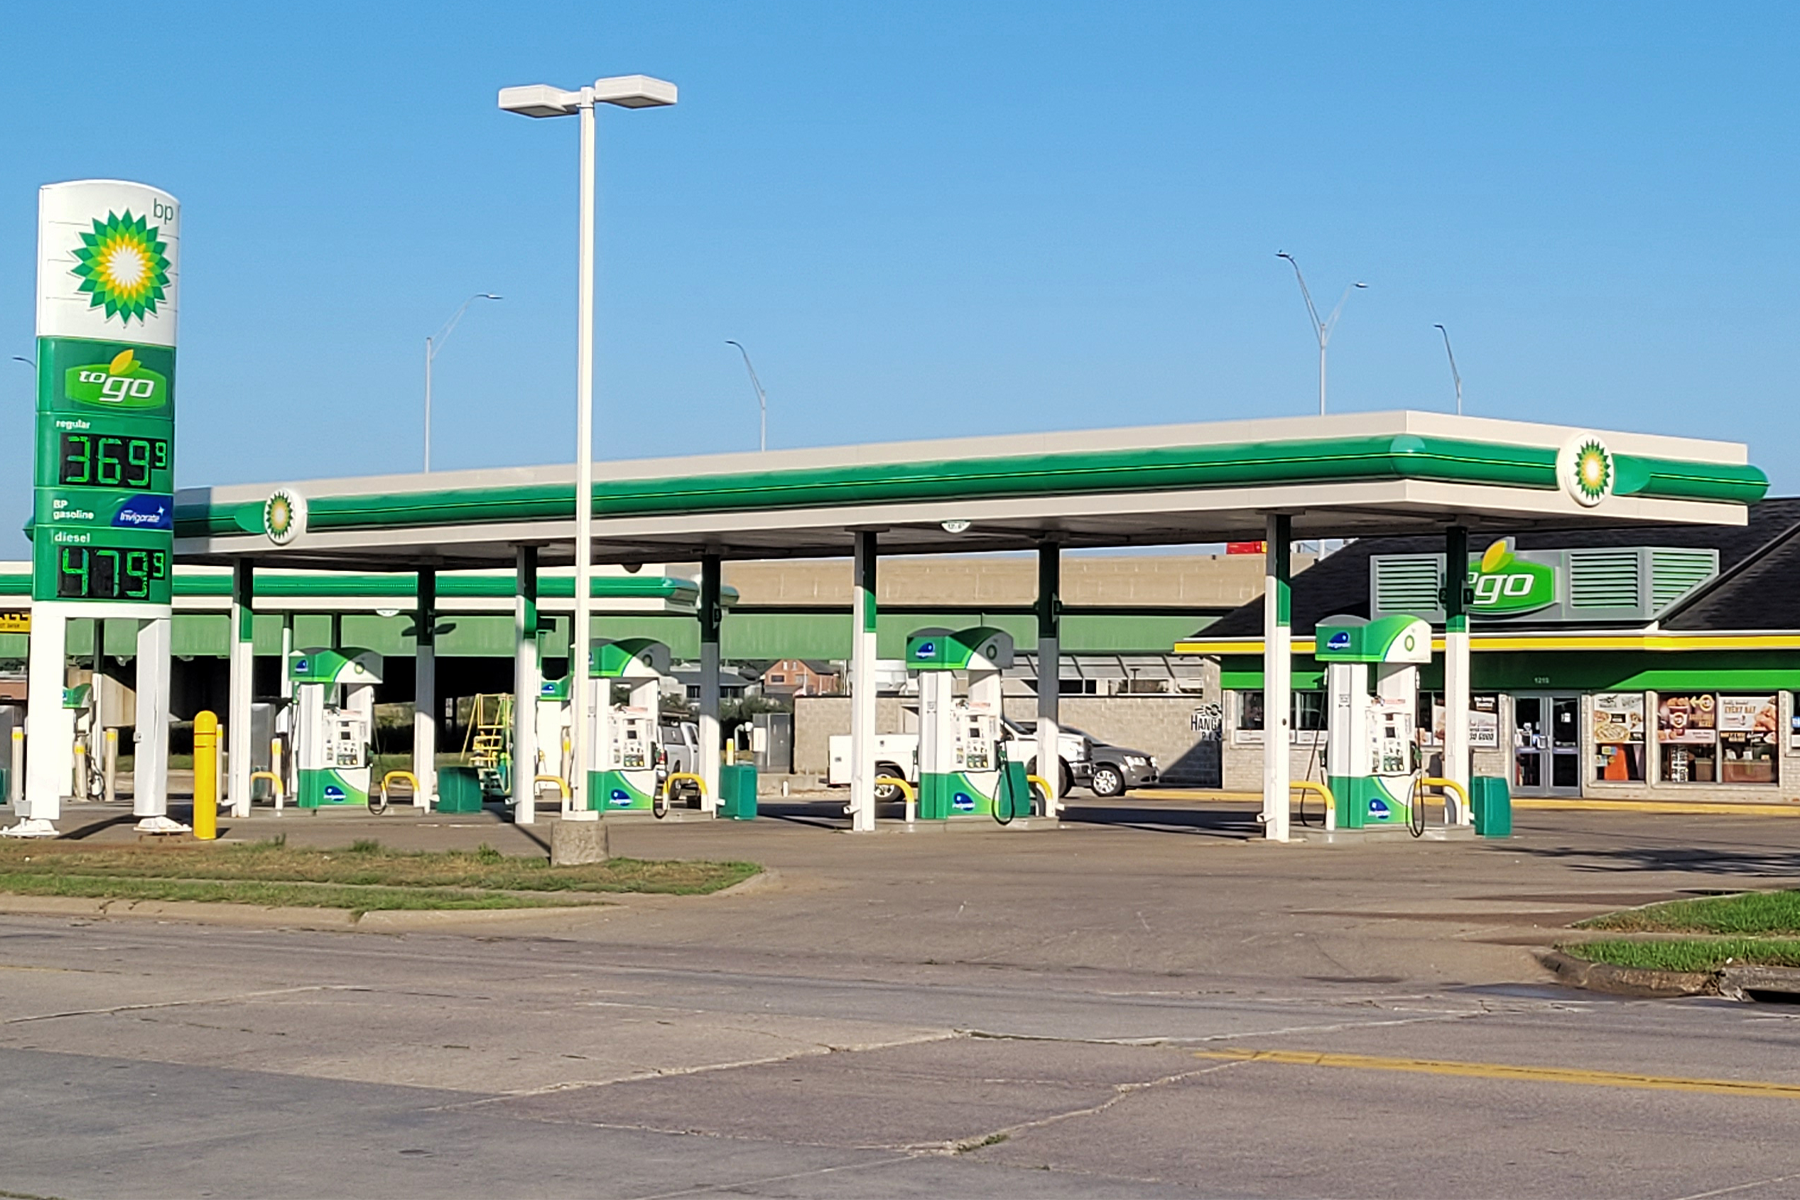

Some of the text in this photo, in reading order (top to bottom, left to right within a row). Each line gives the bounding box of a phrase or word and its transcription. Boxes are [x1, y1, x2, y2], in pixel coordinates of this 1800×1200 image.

[153, 198, 174, 224] bp
[56, 420, 91, 430] regular
[53, 500, 68, 509] BP
[53, 510, 95, 520] gasoline
[55, 532, 91, 543] diesel
